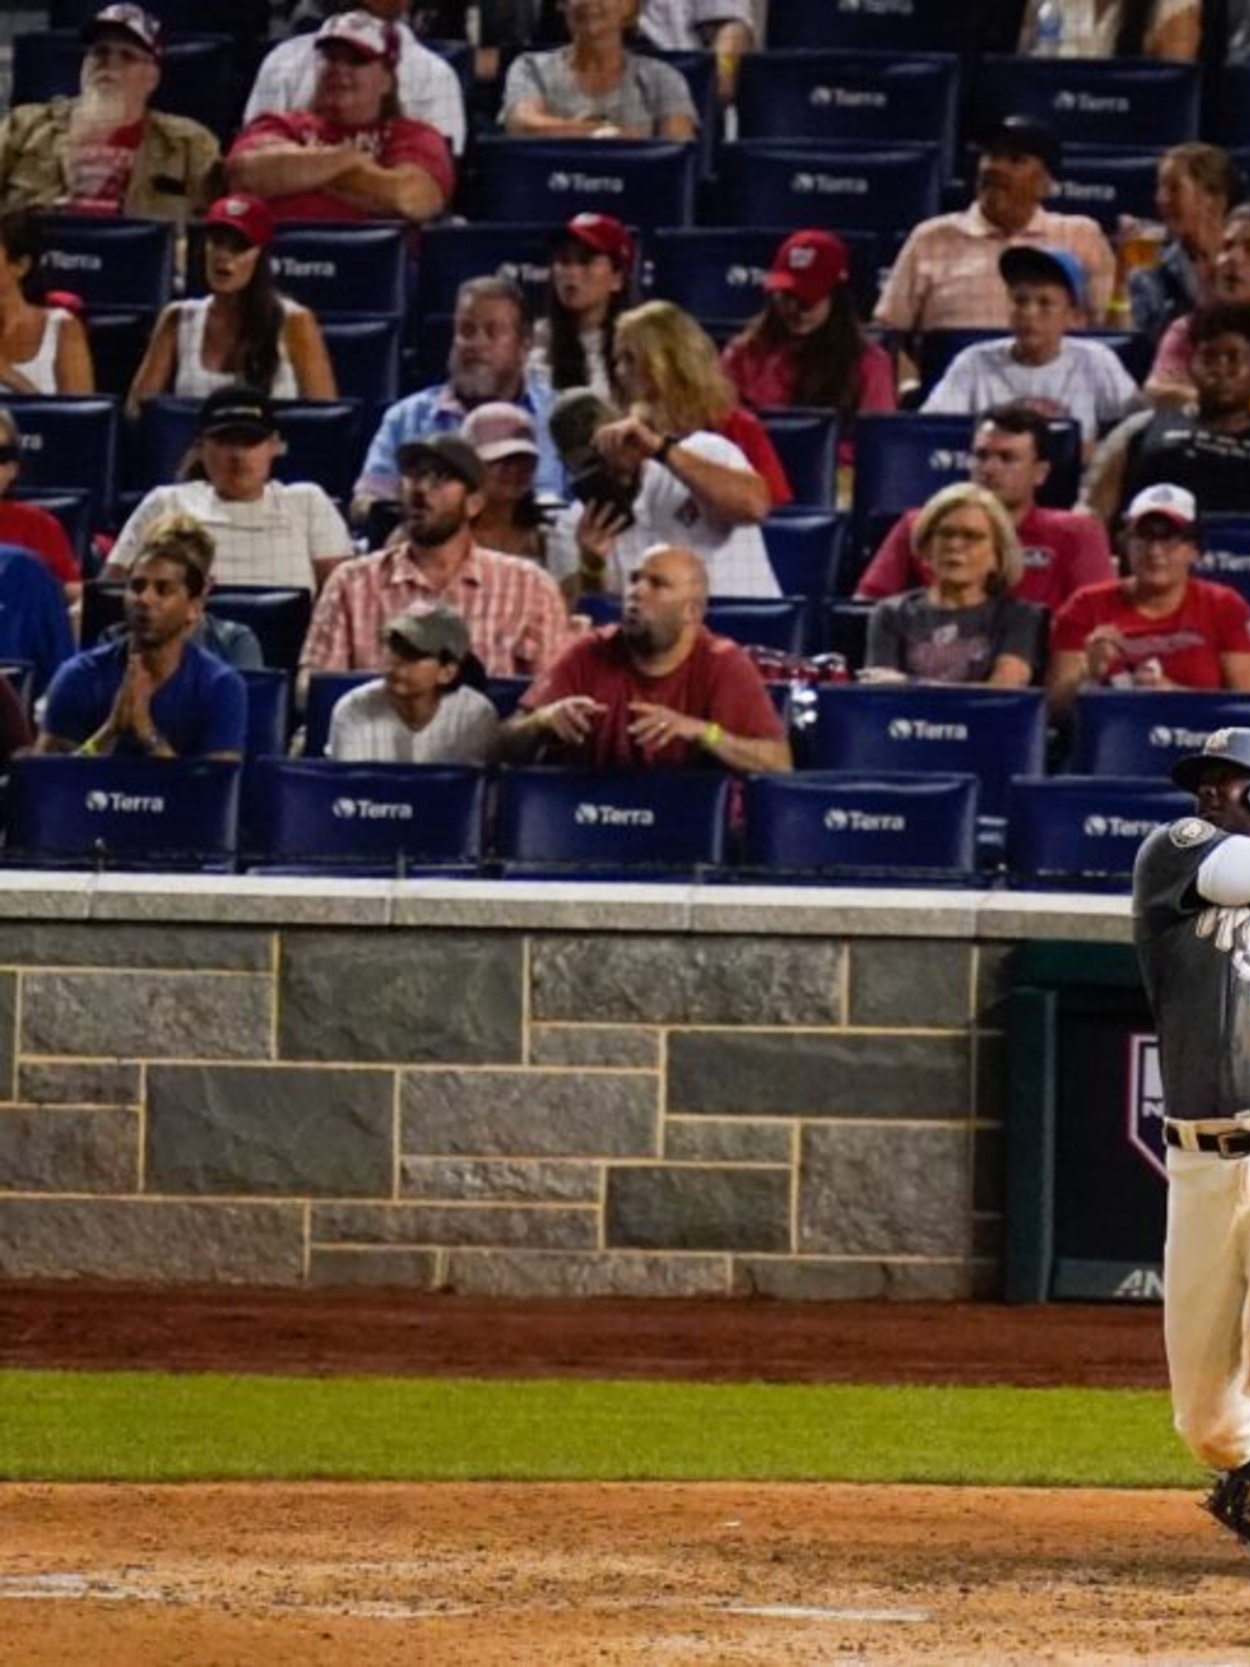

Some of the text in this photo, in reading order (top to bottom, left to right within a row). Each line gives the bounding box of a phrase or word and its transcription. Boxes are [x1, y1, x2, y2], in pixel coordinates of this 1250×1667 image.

[866, 0, 914, 15] Terra
[834, 89, 887, 106] Terra
[1078, 96, 1128, 113] Terra
[570, 173, 623, 193] Terra
[815, 175, 868, 192] Terra
[1065, 183, 1115, 199] Terra
[51, 250, 102, 270] Terra
[282, 256, 335, 277] Terra
[913, 721, 967, 740] Terra
[109, 792, 165, 812] Terra
[359, 801, 413, 820] Terra
[600, 807, 655, 826] Terra
[848, 812, 904, 830] Terra
[1113, 1269, 1164, 1297] AN
